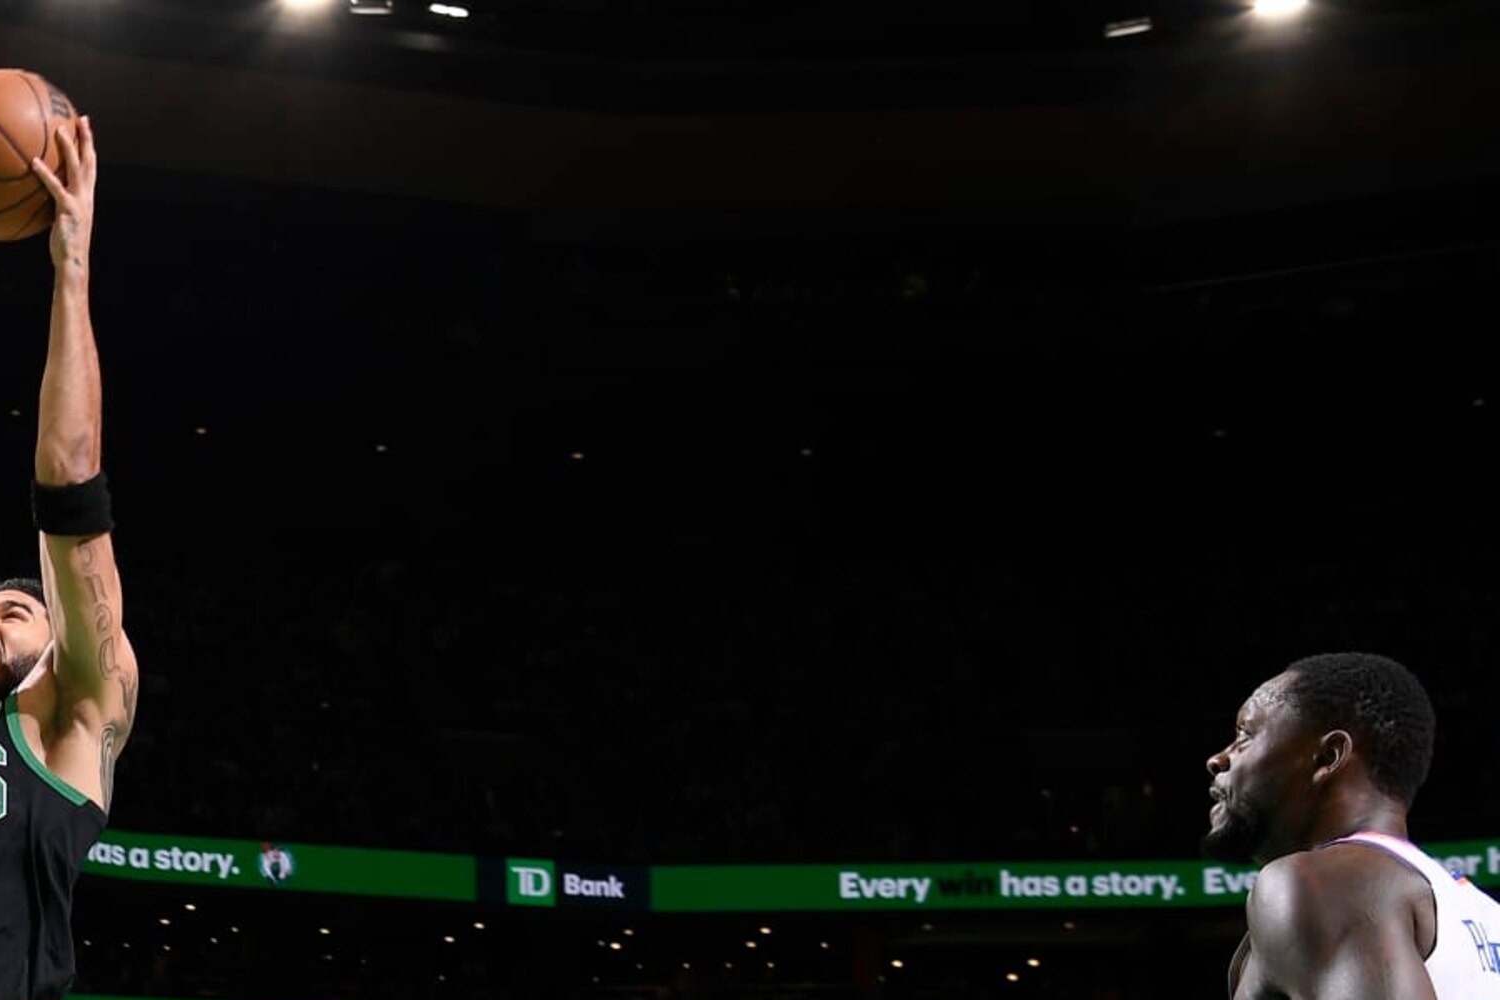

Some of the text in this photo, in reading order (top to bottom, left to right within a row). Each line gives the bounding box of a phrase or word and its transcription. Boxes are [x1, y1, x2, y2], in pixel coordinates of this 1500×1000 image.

[128, 847, 150, 869] a
[154, 846, 241, 879] story.
[510, 866, 625, 898] TD Bank
[839, 866, 1258, 903] Every win has a story. Eve
